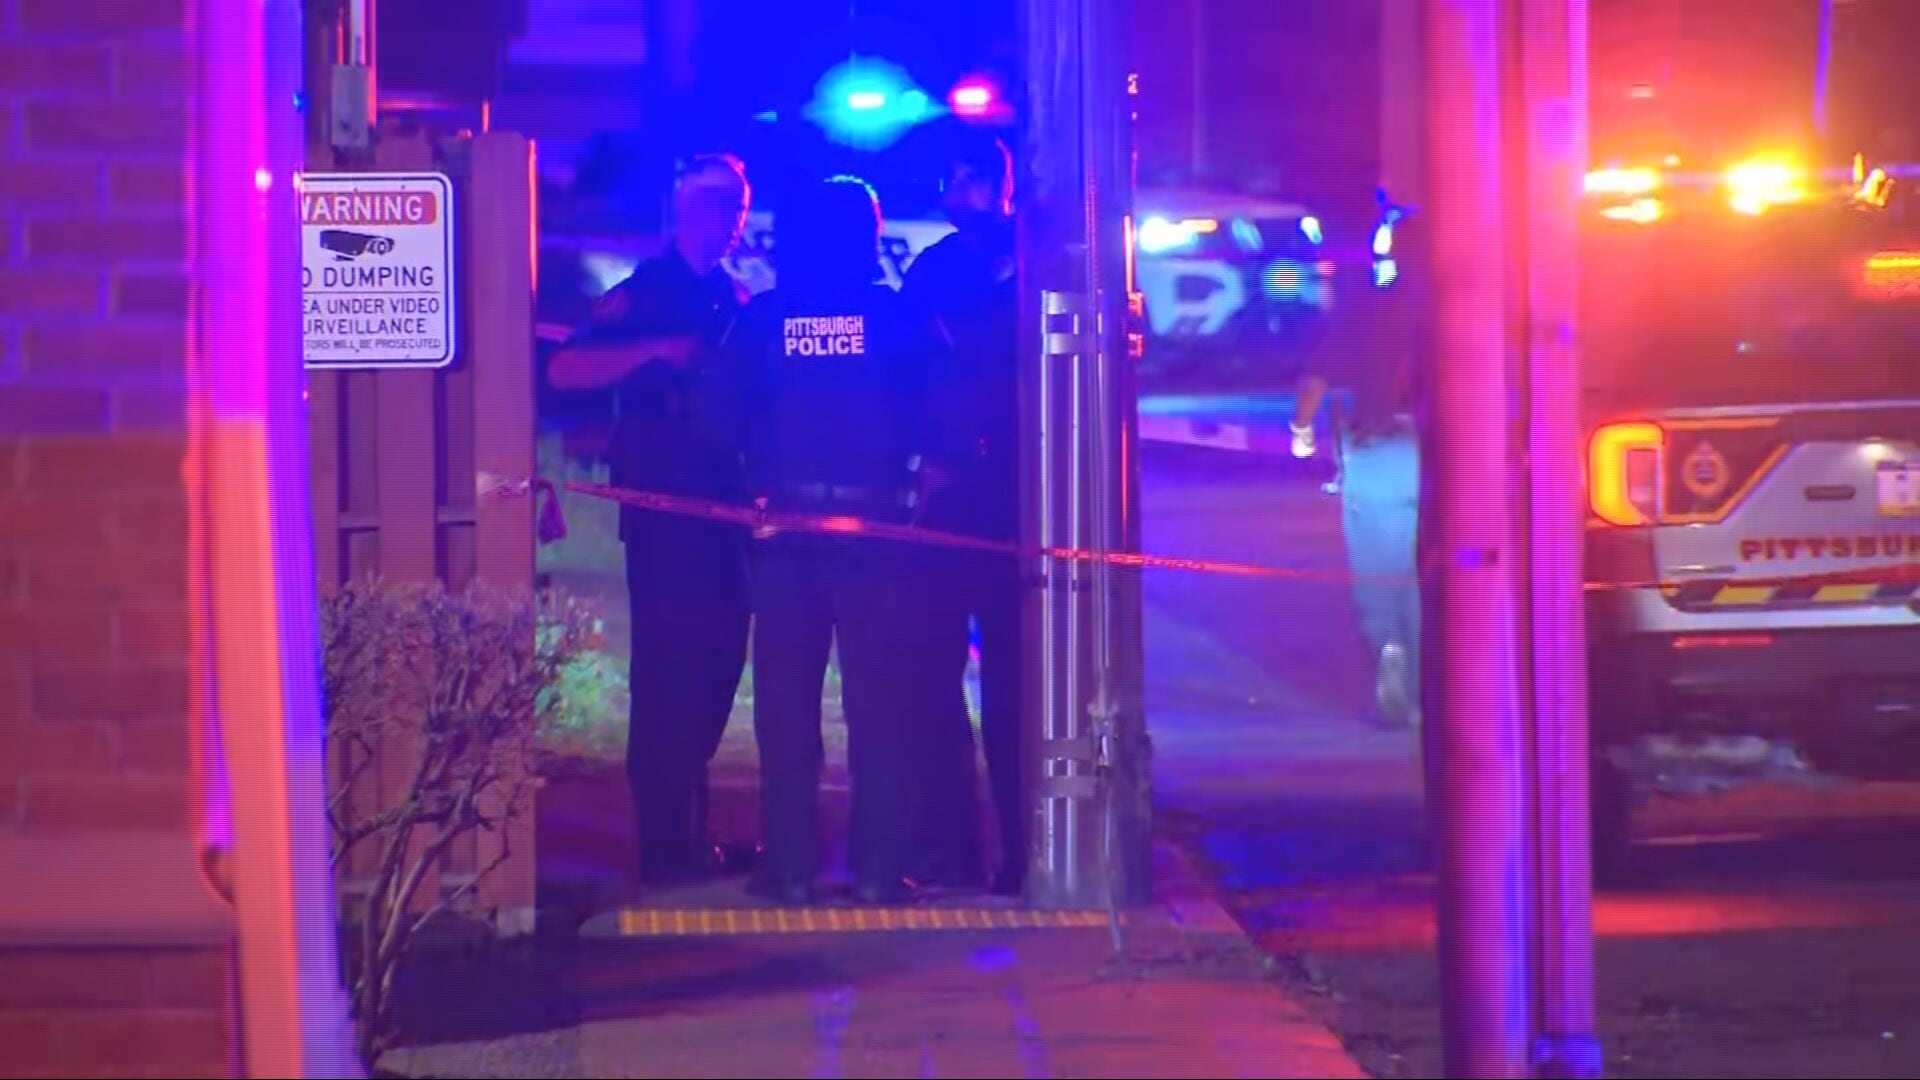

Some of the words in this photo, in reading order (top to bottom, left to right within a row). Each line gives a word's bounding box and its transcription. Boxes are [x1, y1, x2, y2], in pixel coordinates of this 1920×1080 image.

[303, 267, 313, 288] O
[324, 266, 434, 288] DUMPING
[327, 298, 385, 315] UNDER
[389, 297, 440, 314] VIDEO
[303, 318, 427, 335] URVEILLANCE
[784, 316, 864, 336] PITTSBURGH
[375, 338, 441, 349] PROSECUTED
[785, 336, 865, 356] POLICE
